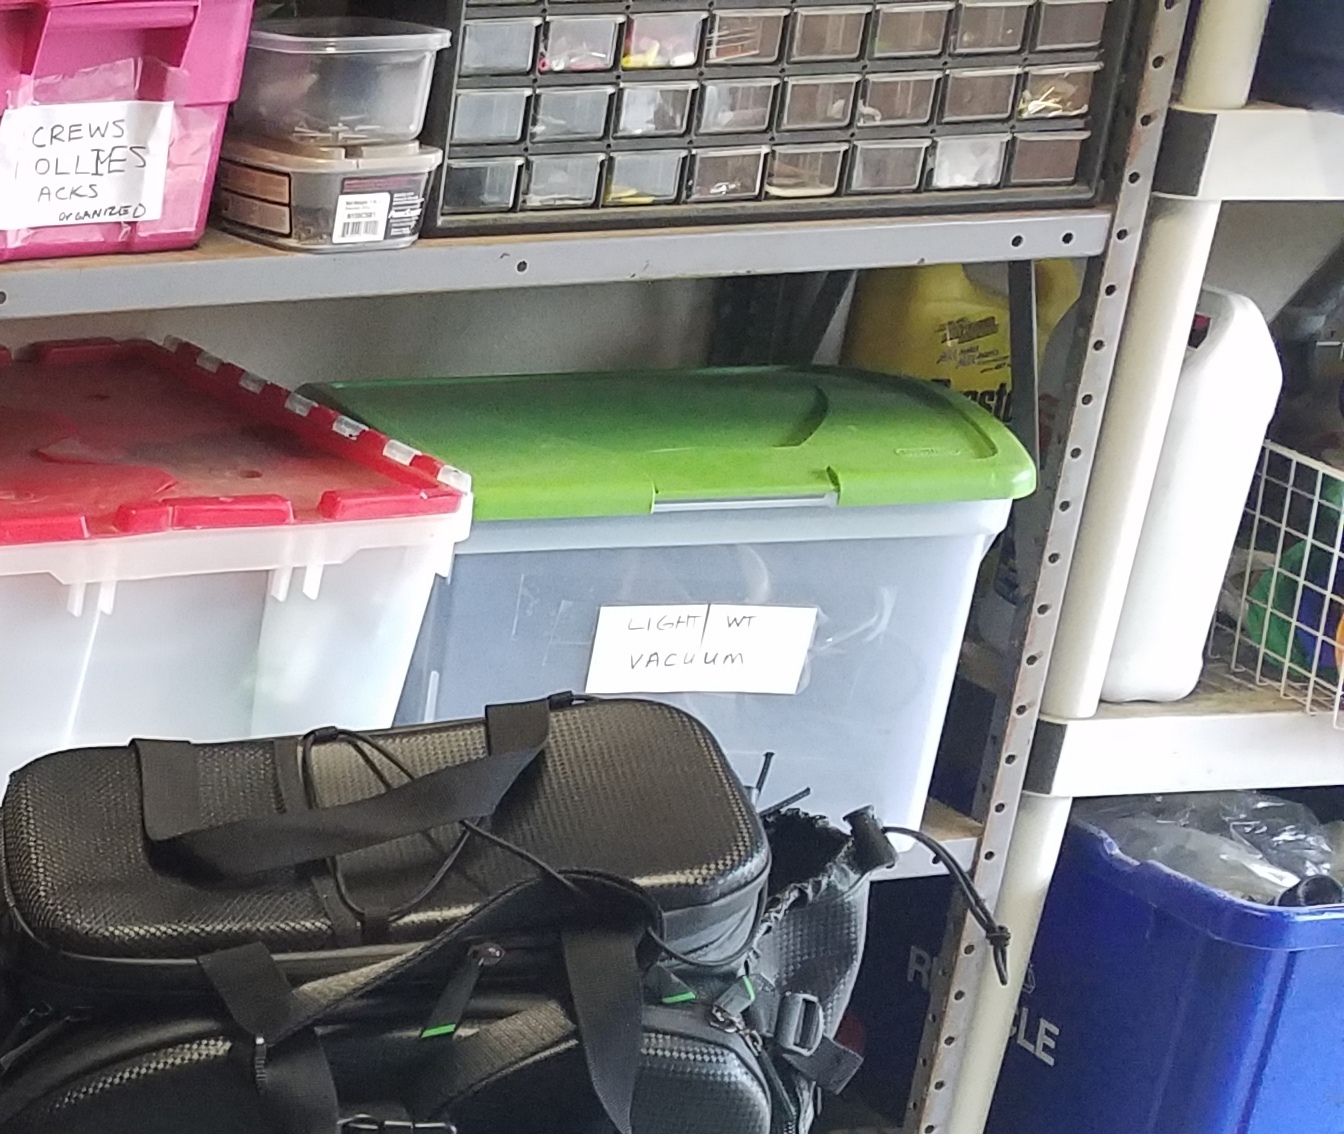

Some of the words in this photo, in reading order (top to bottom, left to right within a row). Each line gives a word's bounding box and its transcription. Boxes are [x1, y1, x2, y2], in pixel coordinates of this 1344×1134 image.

[31, 119, 125, 148] CREWS
[37, 184, 99, 203] ACKS
[627, 615, 702, 631] LIGHT
[726, 615, 757, 628] WT
[630, 651, 744, 670] VACUUM
